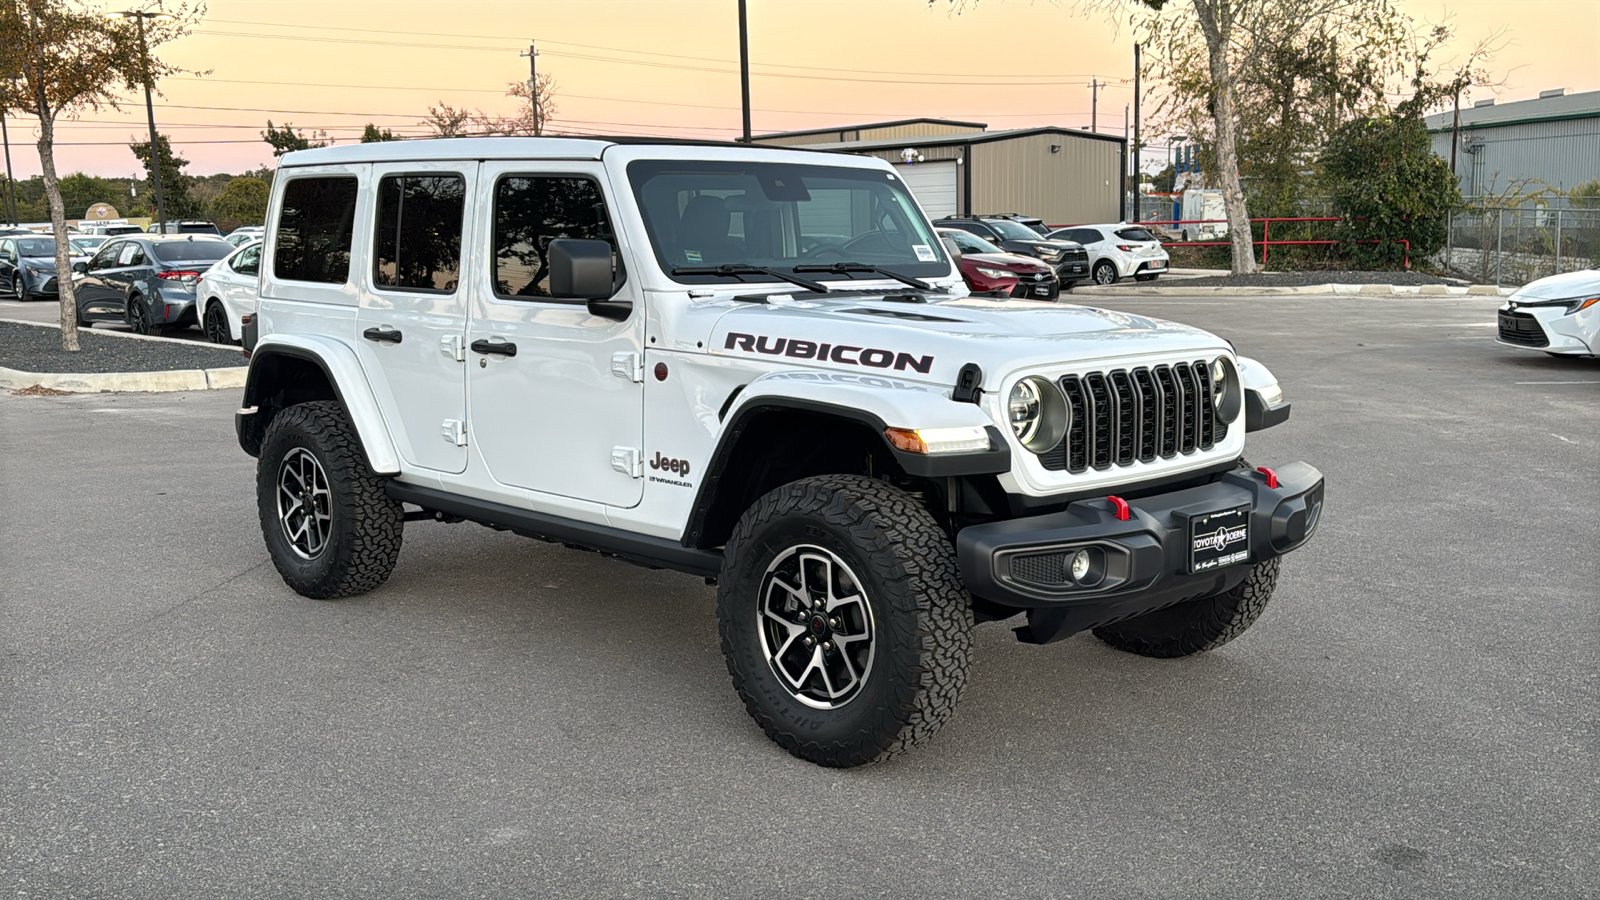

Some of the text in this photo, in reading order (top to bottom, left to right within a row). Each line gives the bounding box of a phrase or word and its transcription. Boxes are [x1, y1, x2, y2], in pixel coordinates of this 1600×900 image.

[724, 332, 934, 373] RUBICON
[649, 451, 691, 478] Jeep
[1194, 536, 1217, 548] TOYOTA
